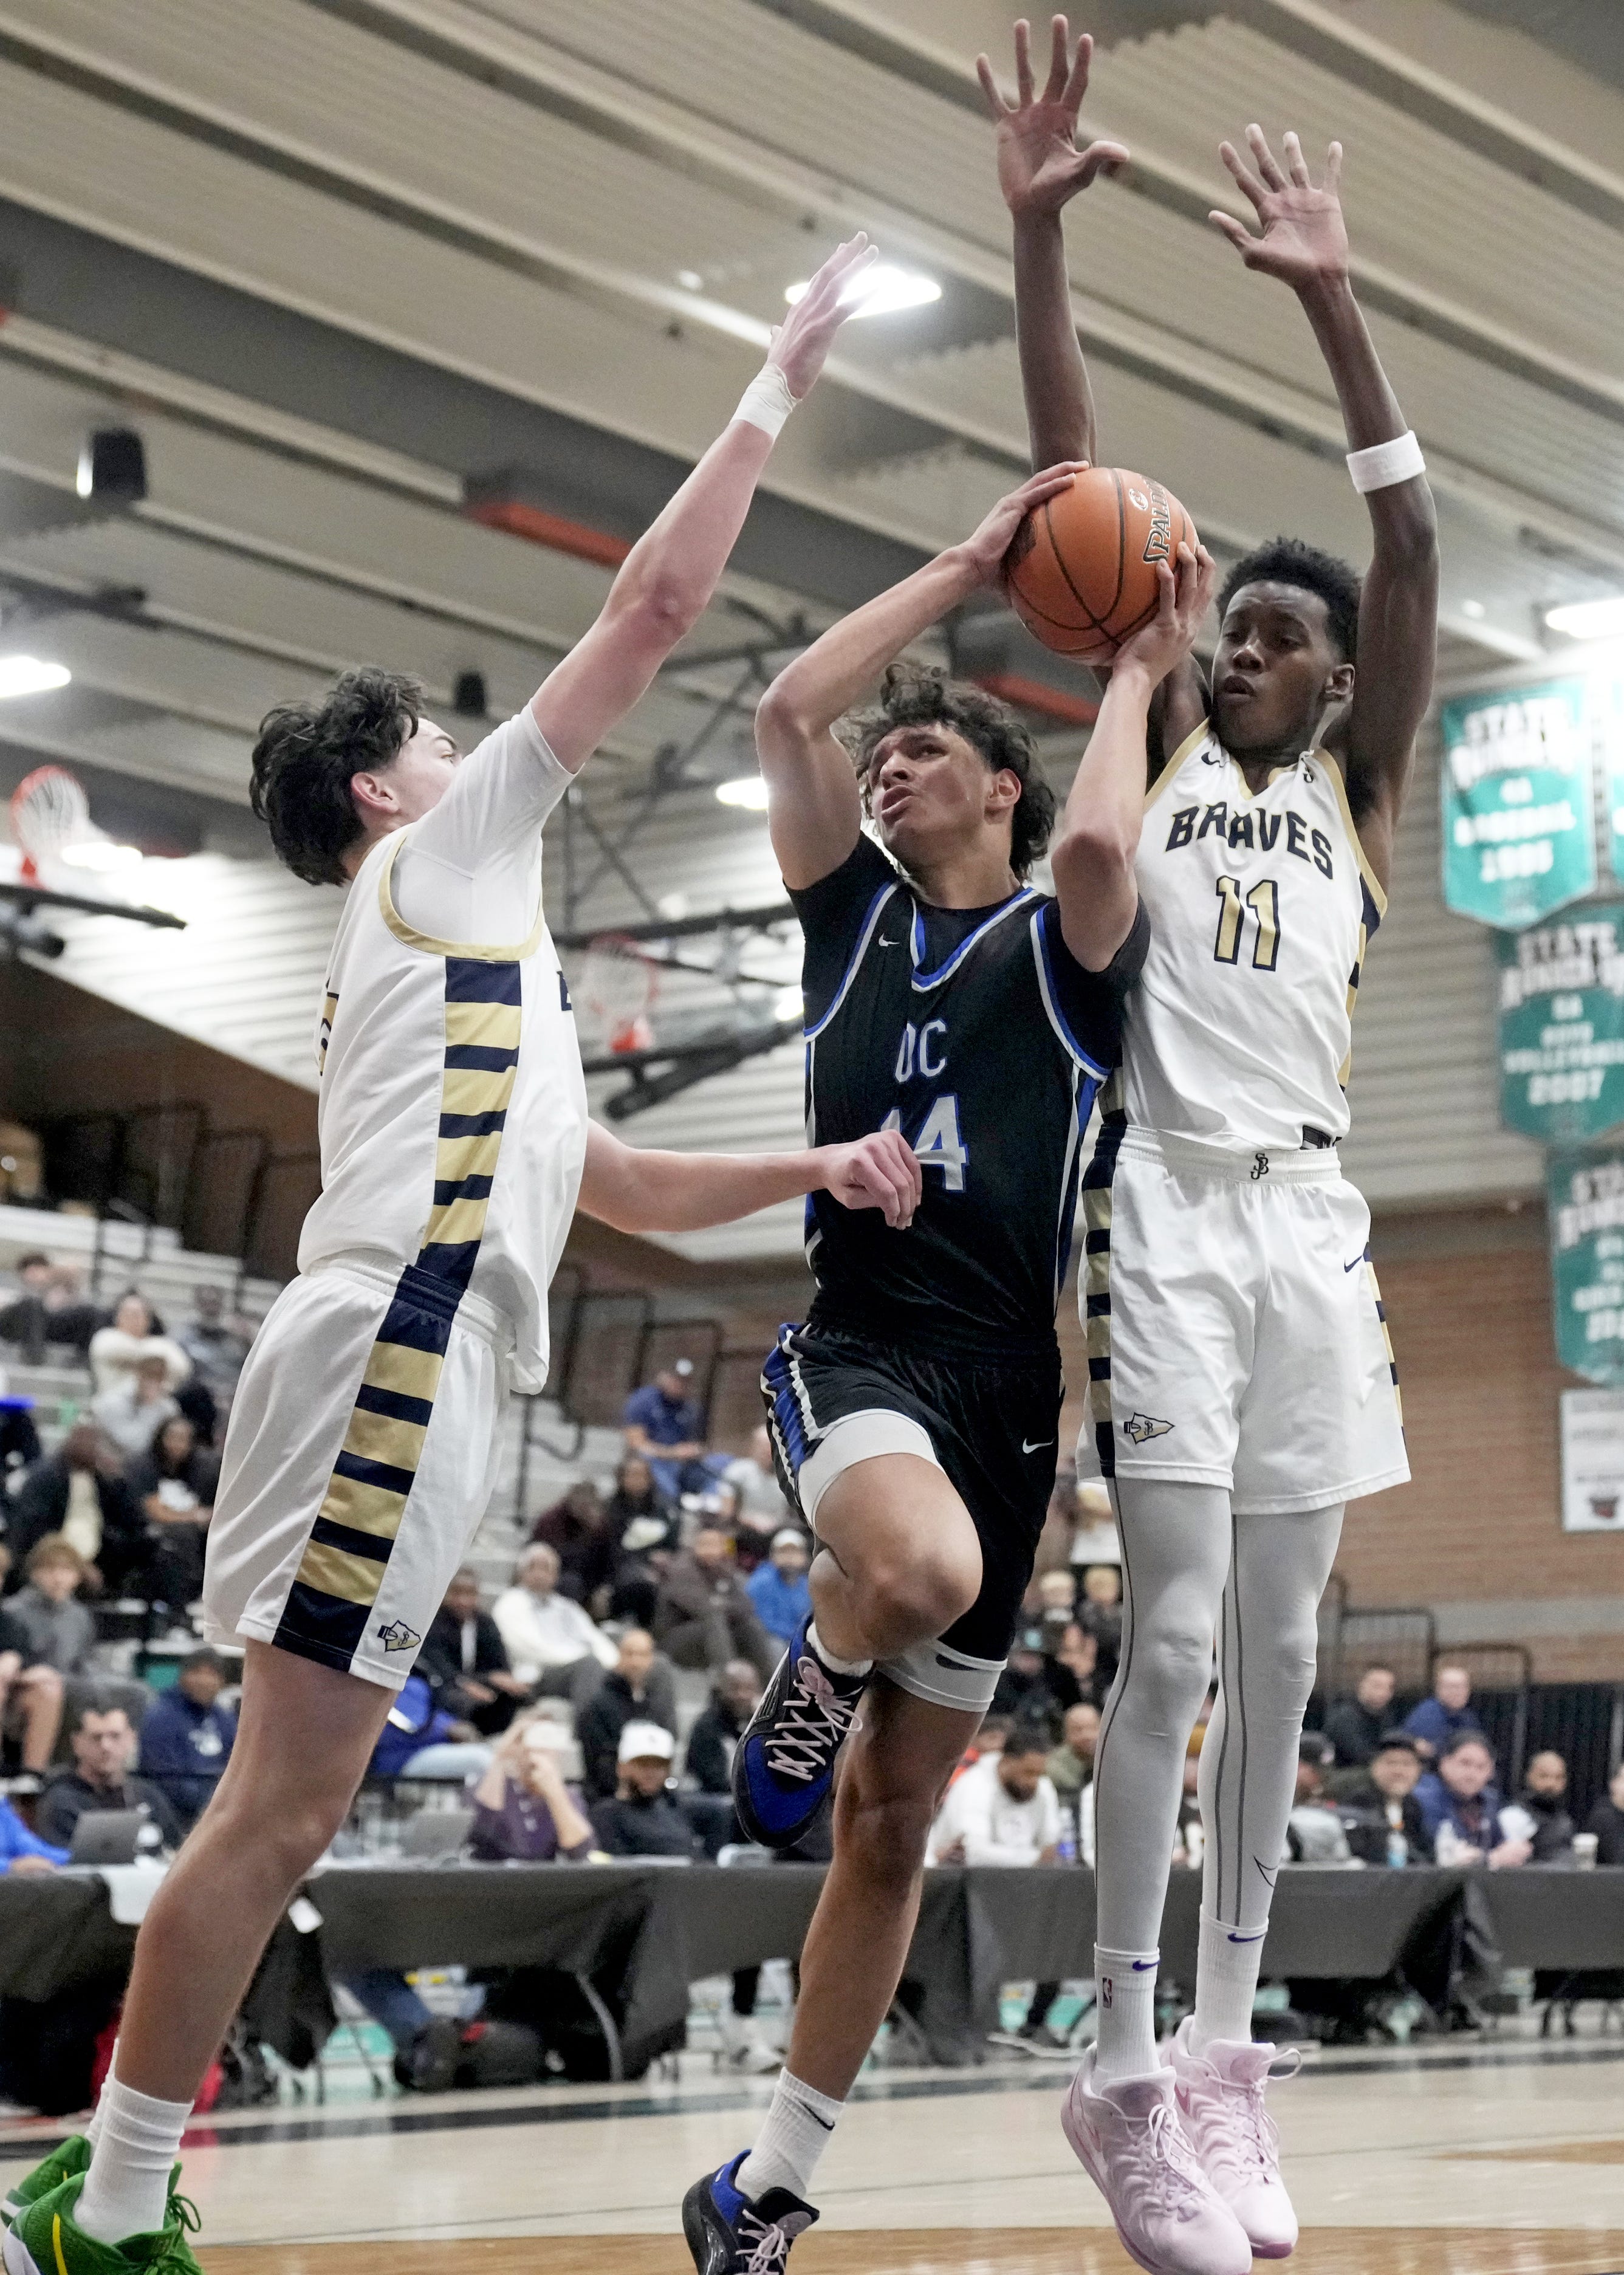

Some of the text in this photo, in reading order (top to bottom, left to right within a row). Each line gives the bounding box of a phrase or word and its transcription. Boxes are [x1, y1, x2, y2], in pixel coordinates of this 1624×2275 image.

[1142, 476, 1171, 564] SPALD
[1164, 801, 1334, 880] BRAVES
[1213, 874, 1281, 972] 11
[894, 1019, 948, 1084] OC
[880, 1094, 970, 1192] 4
